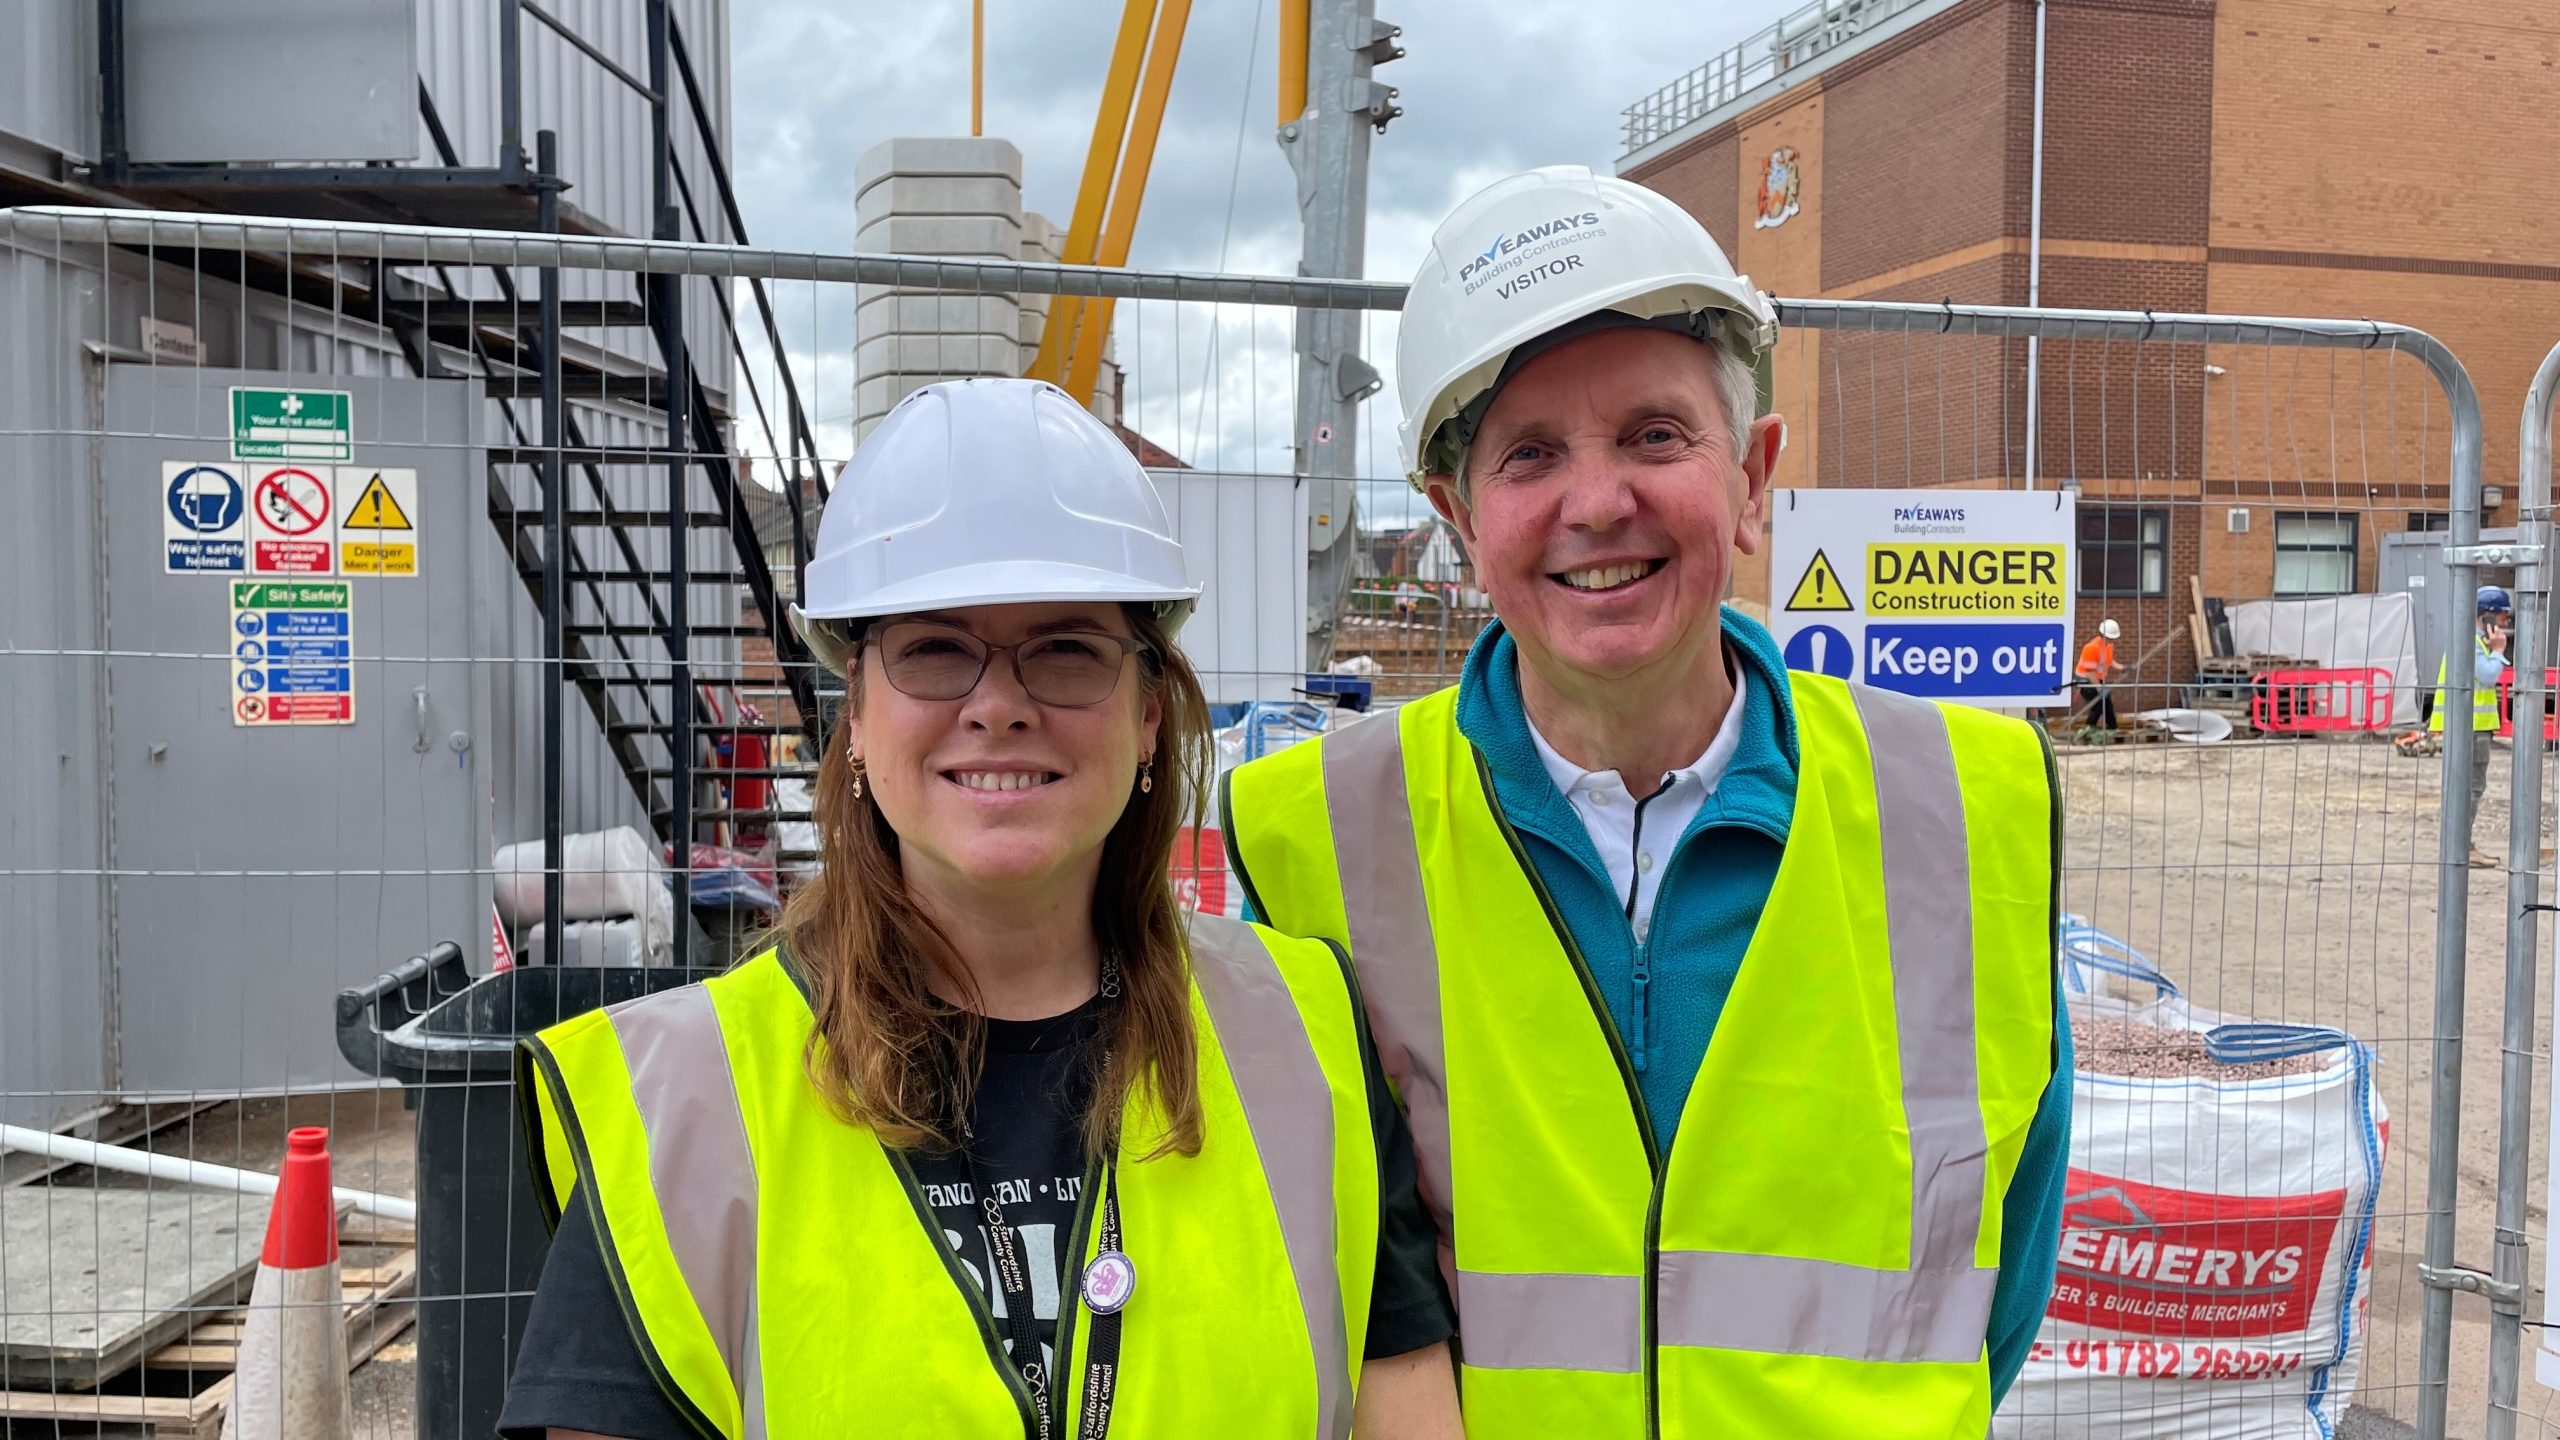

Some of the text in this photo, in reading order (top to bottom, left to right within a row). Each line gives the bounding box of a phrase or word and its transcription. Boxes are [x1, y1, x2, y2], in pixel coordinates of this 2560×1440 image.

[1496, 254, 1584, 300] VISITOR
[168, 542, 244, 558] Wear safety
[185, 555, 231, 568] helmet
[353, 546, 402, 559] Danger
[385, 561, 412, 570] work
[1873, 550, 2058, 586] DANGER
[268, 588, 346, 604] Site Safety
[1871, 590, 2060, 611] Construction site
[1870, 637, 2058, 684] Keep out
[990, 1225, 1017, 1293] County Council
[998, 1225, 1024, 1292] Staffordshire
[2057, 1226, 2303, 1286] EMERYS
[2085, 1291, 2099, 1307] &
[2103, 1294, 2188, 1320] BUILDERS
[2191, 1300, 2288, 1322] MERCHANTS
[2066, 1340, 2182, 1379] 01782
[1084, 1363, 1101, 1437] Staffordshire
[1094, 1363, 1113, 1439] County Council
